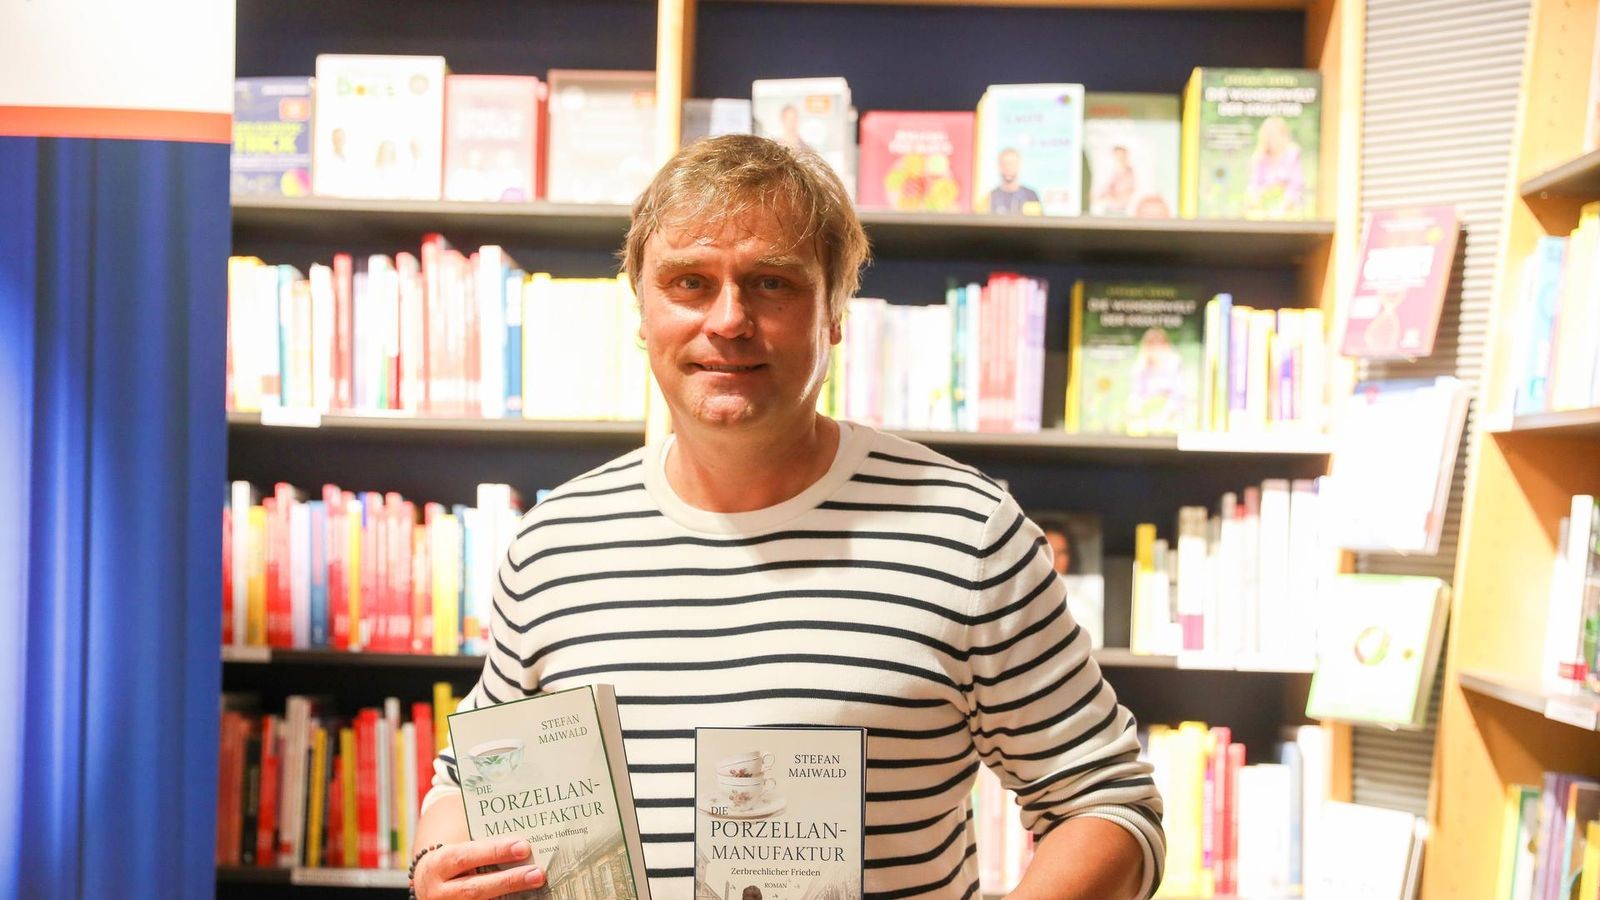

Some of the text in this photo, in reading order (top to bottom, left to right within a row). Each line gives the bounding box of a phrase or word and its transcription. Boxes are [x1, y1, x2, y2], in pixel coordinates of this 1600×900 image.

[541, 714, 580, 731] STEFAN
[538, 726, 588, 745] MAIWALD
[794, 754, 840, 765] STEFAN
[788, 767, 847, 779] MAIWALD
[476, 784, 493, 796] DIE
[479, 778, 600, 816] PORZELLAN-
[711, 806, 729, 816] DIE
[485, 801, 604, 837] MANUFAKTUR
[555, 826, 588, 840] Hoffnung
[711, 820, 847, 840] PORZELLAN-
[539, 845, 559, 855] ROMAN
[712, 845, 846, 863] MANUFAKTUR
[731, 867, 821, 877] Zerbrechlicher Frieden
[764, 882, 788, 890] ROMAN
